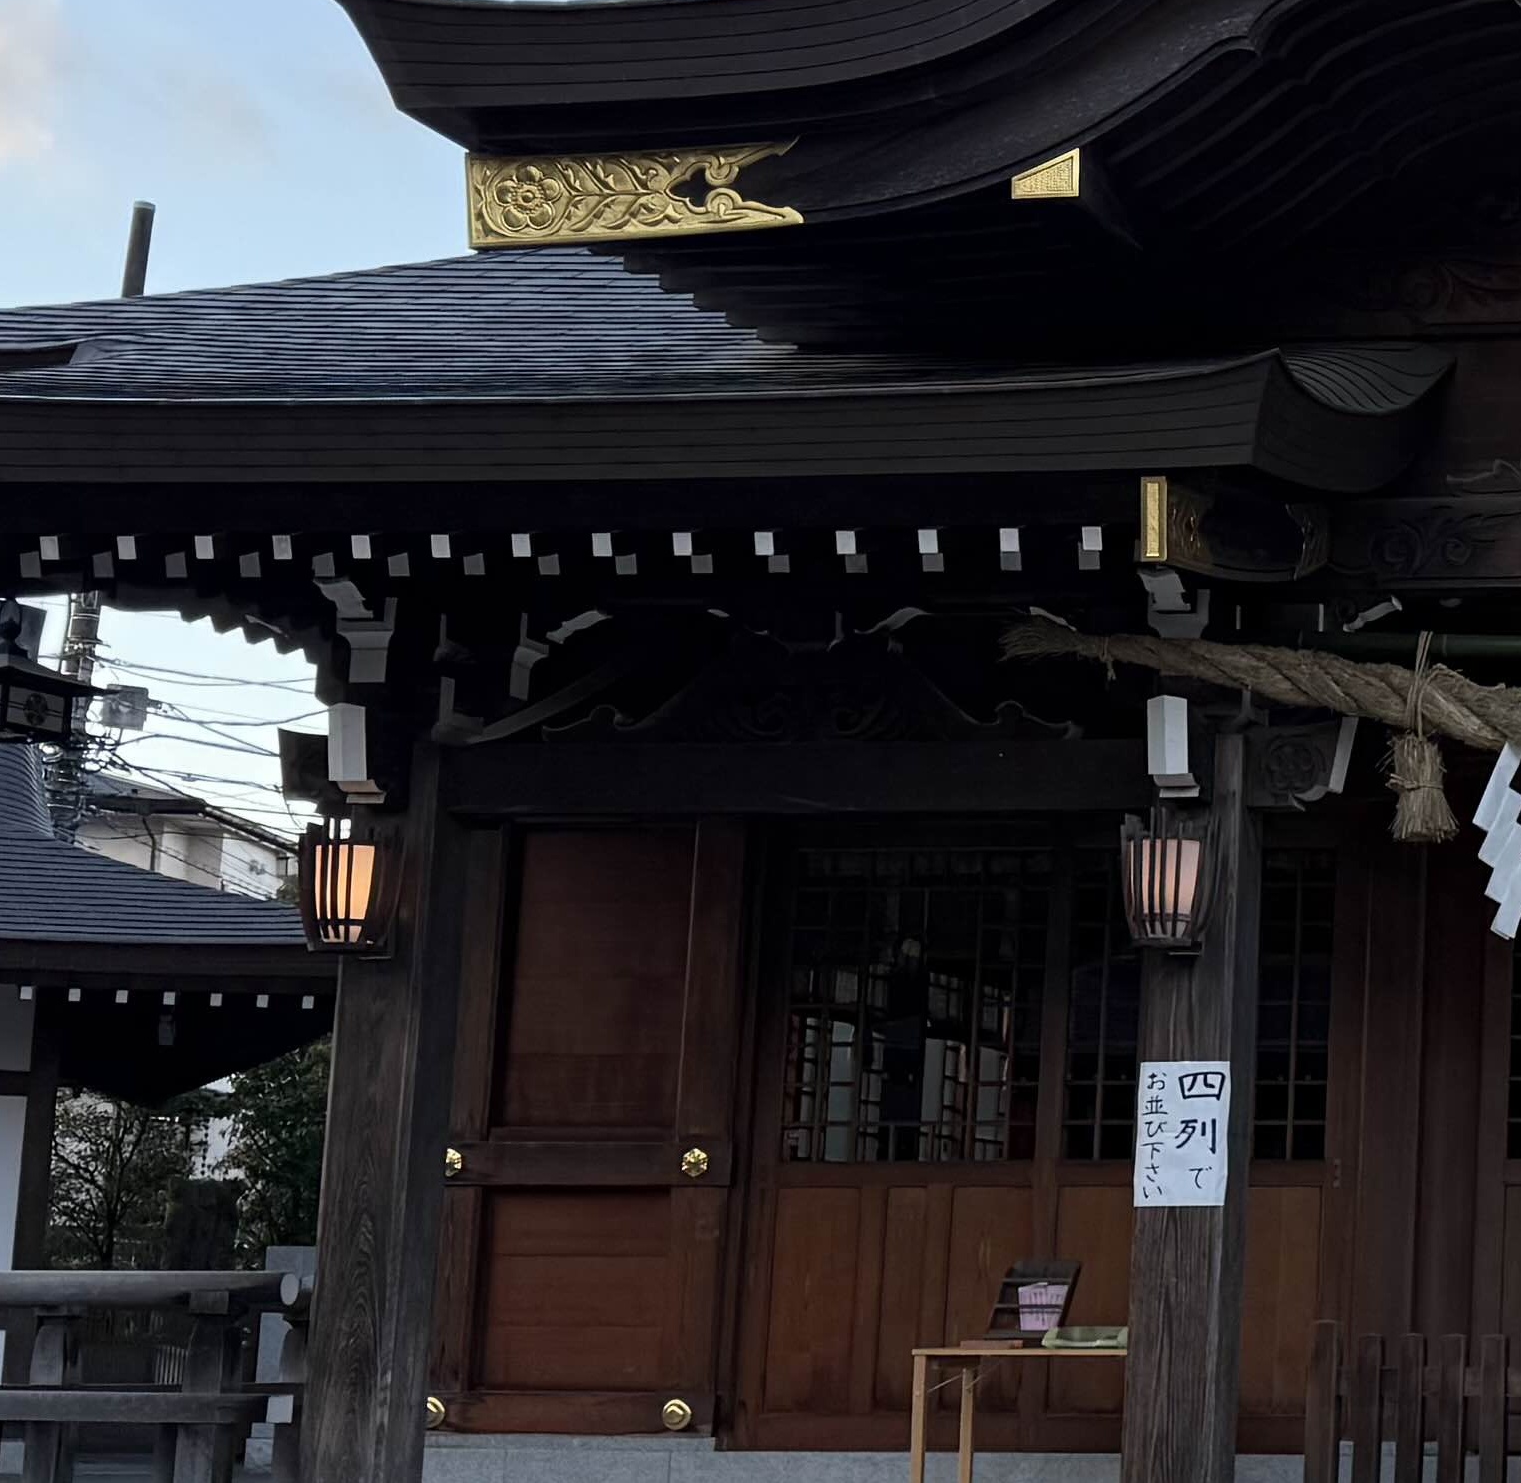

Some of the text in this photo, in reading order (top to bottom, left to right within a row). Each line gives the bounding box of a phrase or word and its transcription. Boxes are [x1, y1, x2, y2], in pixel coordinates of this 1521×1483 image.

[1141, 1071, 1168, 1199] お並び下さい
[1174, 1071, 1226, 1189] 四列で
